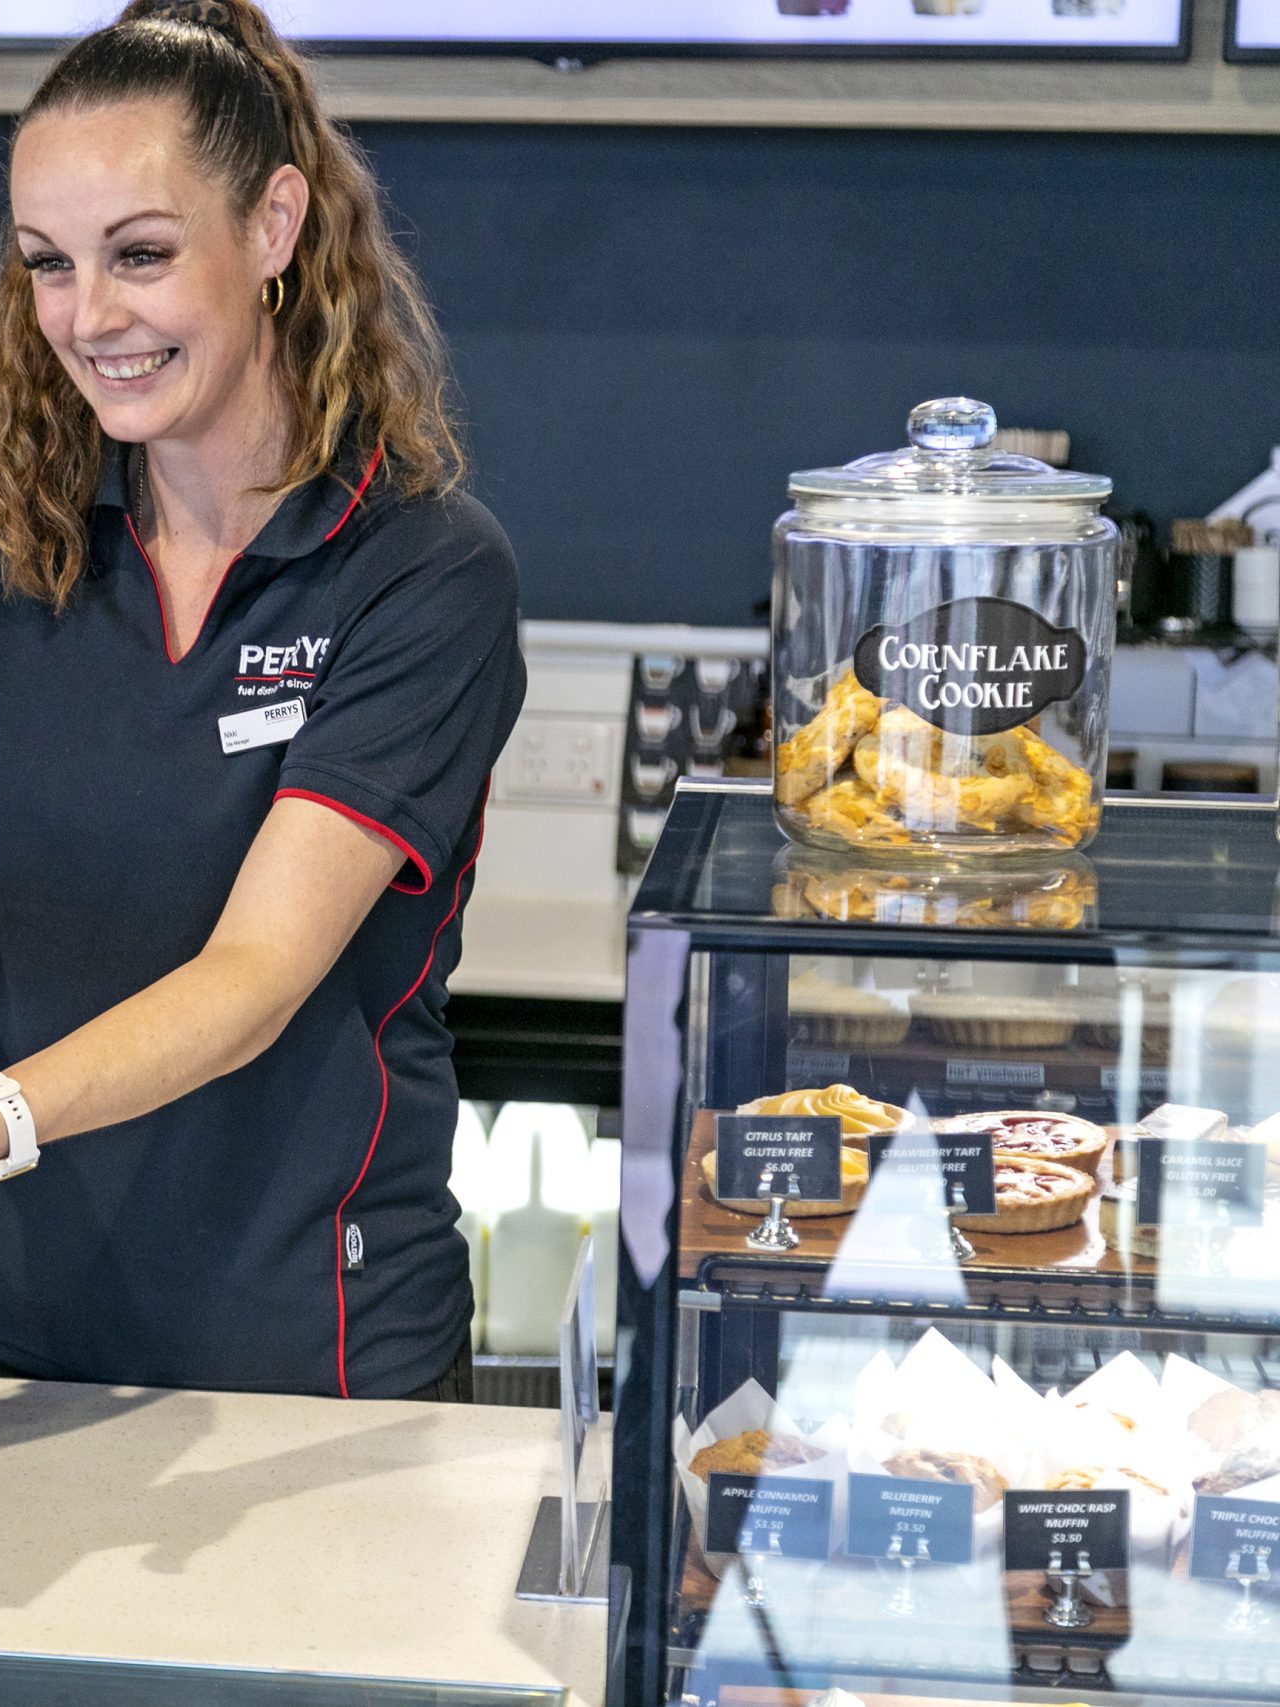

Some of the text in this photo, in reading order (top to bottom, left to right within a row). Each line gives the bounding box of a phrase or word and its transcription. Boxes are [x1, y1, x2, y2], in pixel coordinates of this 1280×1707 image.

[878, 635, 1069, 673] CORNFLAKE
[238, 686, 255, 695] fuel
[919, 674, 1033, 710] COOKIE
[264, 703, 299, 720] PERRYS
[745, 1131, 814, 1142] CITRUS TART
[743, 1147, 814, 1157] GLUTEN FREE
[881, 1147, 982, 1159] STRAWBERRY TART
[1162, 1155, 1243, 1167] CARAMEL SLICE
[765, 1162, 794, 1173] $6.00
[941, 1162, 967, 1172] FREE
[1167, 1171, 1238, 1182] GLUTEN FREE
[723, 1487, 819, 1504] APPLE CINNAMON
[881, 1491, 942, 1505] BLUEBERRY
[748, 1504, 791, 1515] MUFFIN
[889, 1507, 932, 1518] MUFFIN
[1019, 1503, 1116, 1513] WHITE CHOC RASP
[1045, 1519, 1089, 1528] MUFFIN
[1211, 1510, 1280, 1526] TRIPLE CHOC
[754, 1519, 784, 1530] $3.50
[896, 1522, 926, 1533] $3.50
[1052, 1533, 1082, 1544] $3.50
[1236, 1528, 1279, 1541] MUFFIN
